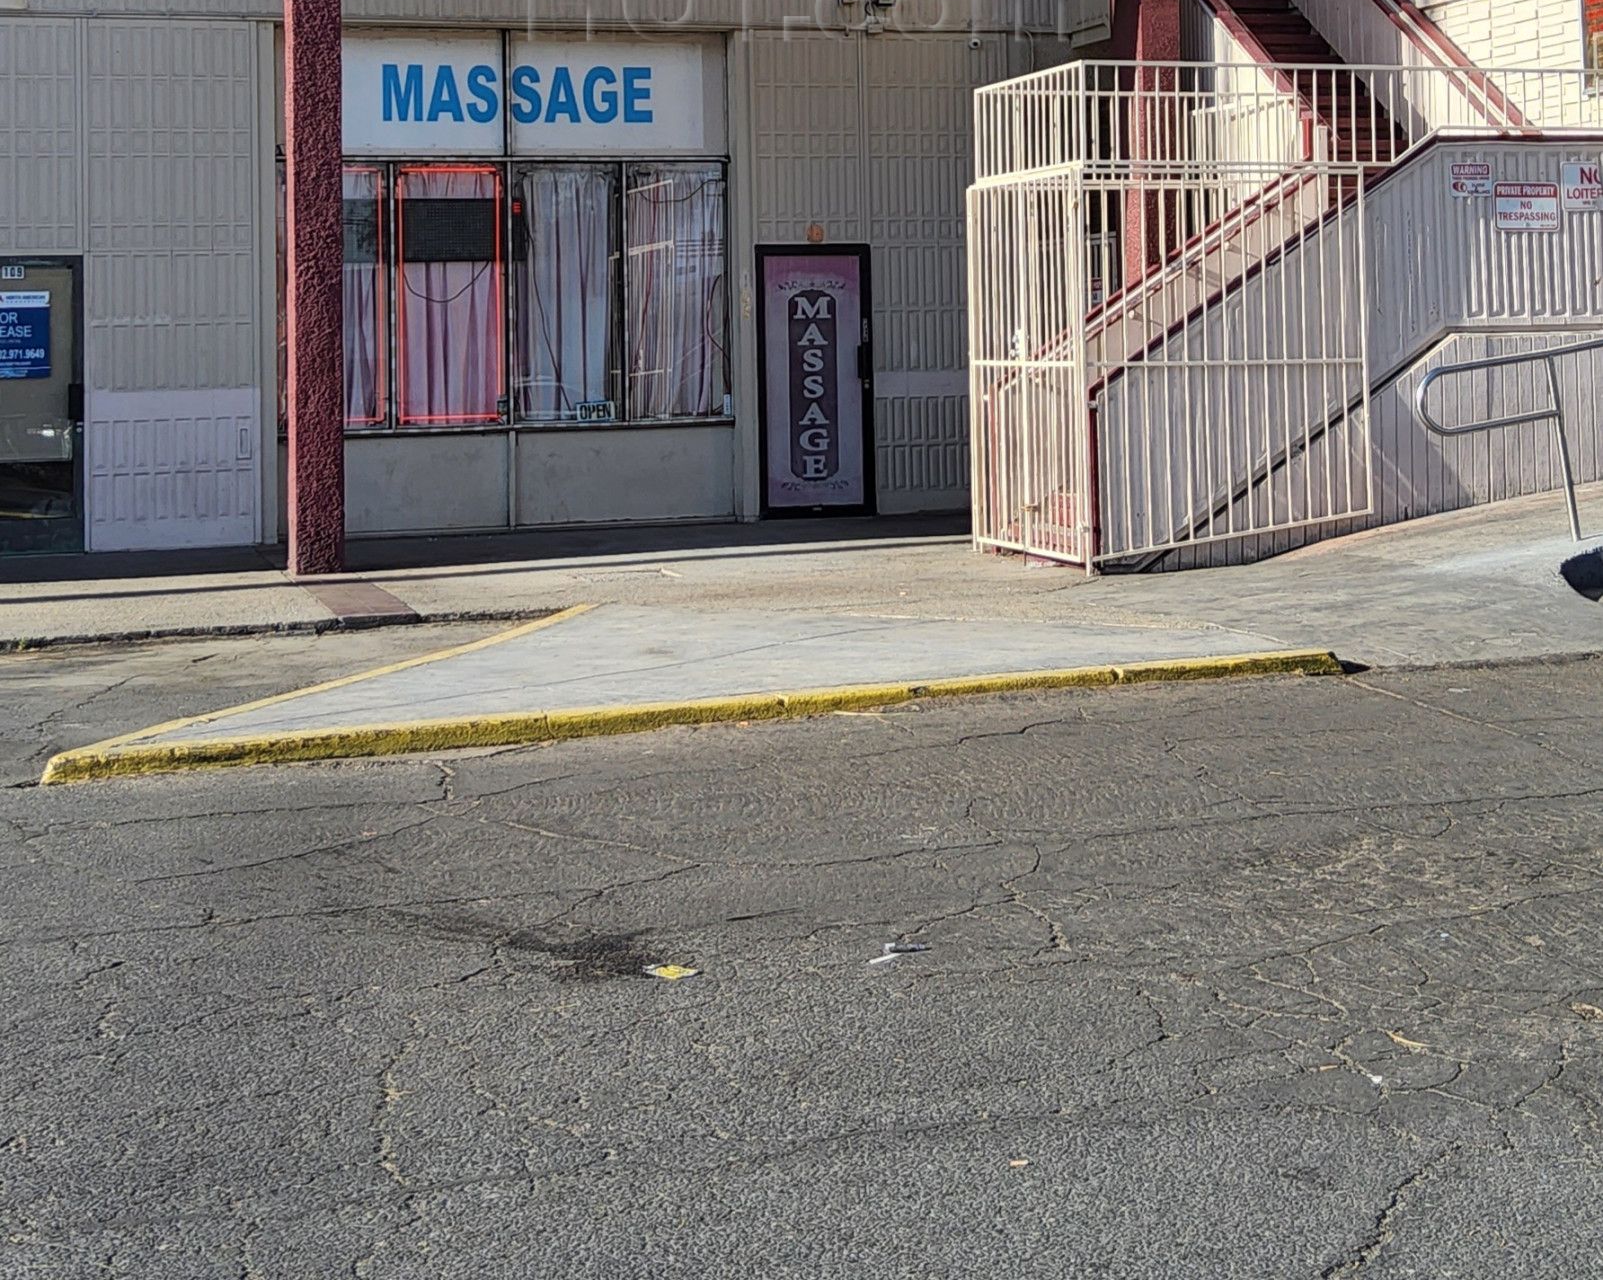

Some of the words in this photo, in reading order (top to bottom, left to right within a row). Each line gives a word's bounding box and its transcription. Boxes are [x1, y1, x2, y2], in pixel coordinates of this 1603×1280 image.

[381, 63, 653, 125] MASSAGE
[1452, 165, 1487, 175] WARNING
[1497, 186, 1521, 196] PRIVATE
[1523, 185, 1555, 196] PROPERTY
[1520, 201, 1532, 210] NO
[1498, 212, 1556, 221] TRESPASSING
[4, 267, 23, 278] 109
[793, 296, 832, 478] MASSAGE
[580, 402, 612, 420] OPEN
